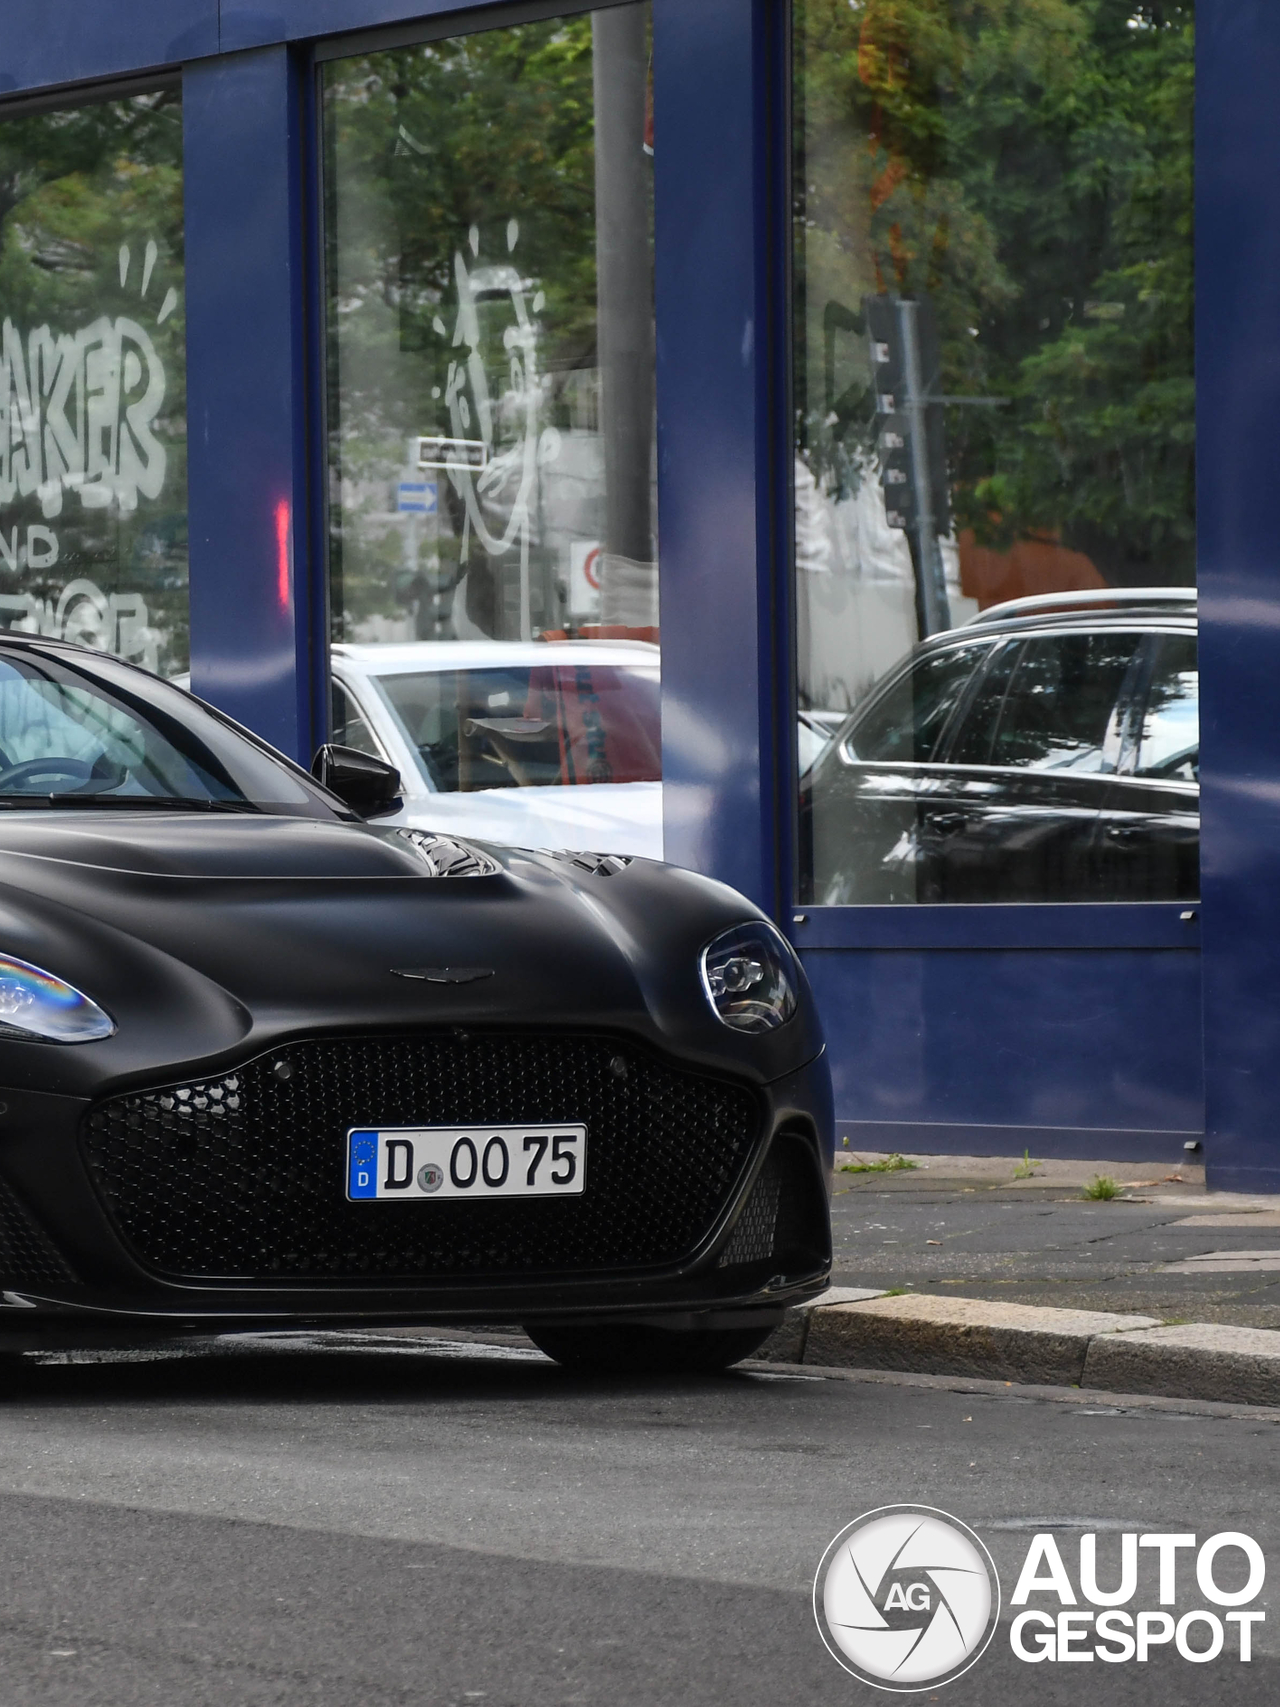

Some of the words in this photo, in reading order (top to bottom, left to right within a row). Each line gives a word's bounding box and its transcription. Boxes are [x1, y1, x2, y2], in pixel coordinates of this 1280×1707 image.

[384, 1139, 414, 1189] D
[523, 1135, 577, 1186] 75
[357, 1172, 369, 1187] D
